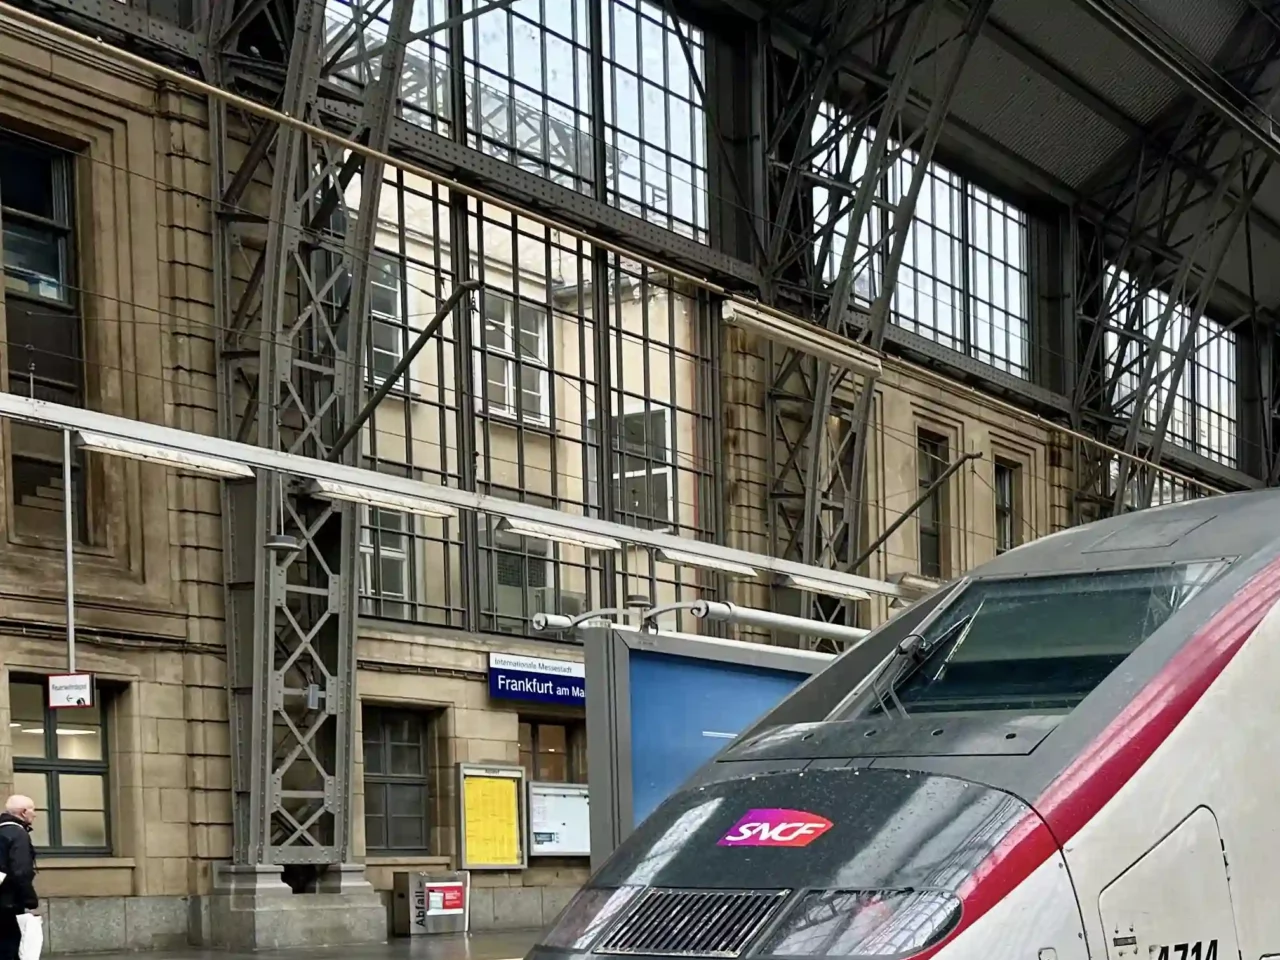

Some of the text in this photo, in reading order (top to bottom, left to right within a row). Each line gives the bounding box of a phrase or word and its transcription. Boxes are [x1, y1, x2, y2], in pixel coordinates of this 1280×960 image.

[494, 657, 572, 674] Internationale Messestadt
[497, 674, 554, 695] Frankfurt
[556, 687, 570, 697] am
[725, 822, 826, 842] SNCF
[414, 890, 426, 928] Abfall
